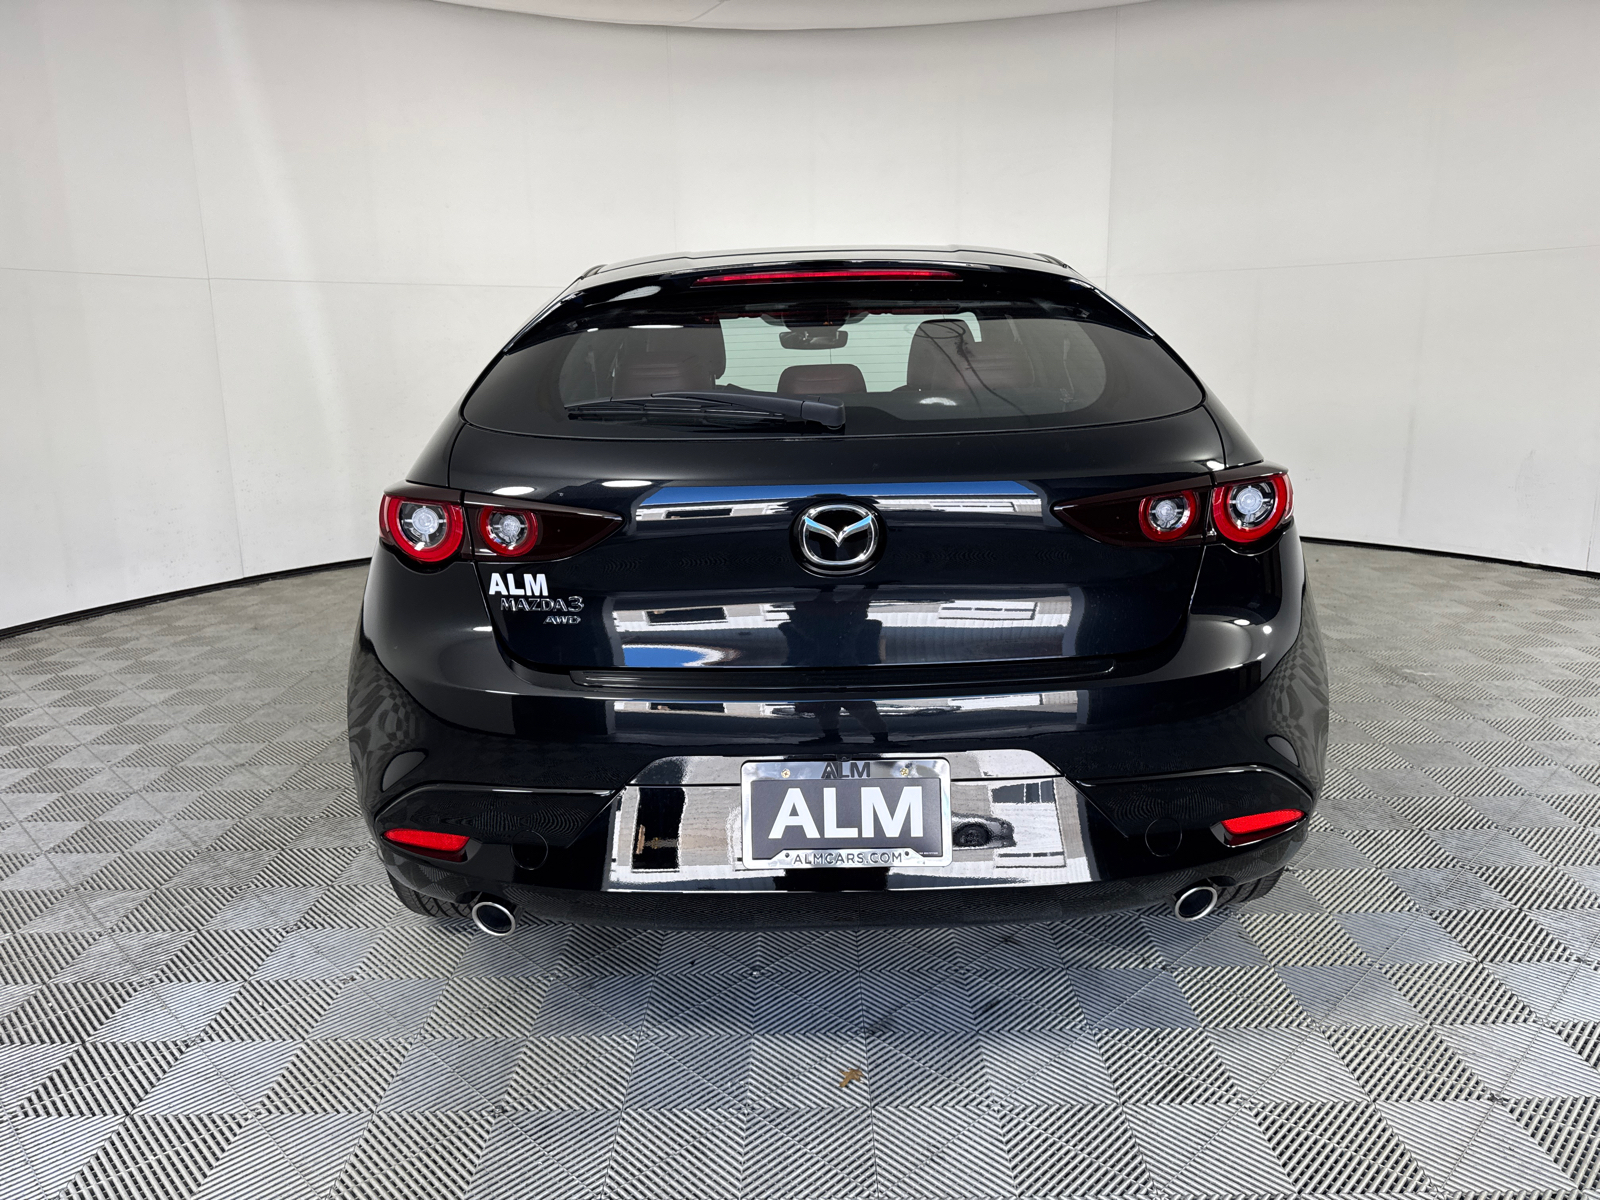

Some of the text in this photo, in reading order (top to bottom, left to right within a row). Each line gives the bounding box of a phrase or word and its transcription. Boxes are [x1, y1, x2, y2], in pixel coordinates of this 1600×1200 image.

[488, 572, 549, 596] ALM
[500, 595, 585, 613] MAZDA3
[543, 615, 581, 625] AWD
[821, 761, 871, 779] ALM
[768, 786, 924, 839] ALM
[793, 851, 902, 865] ALMCARS.COM
